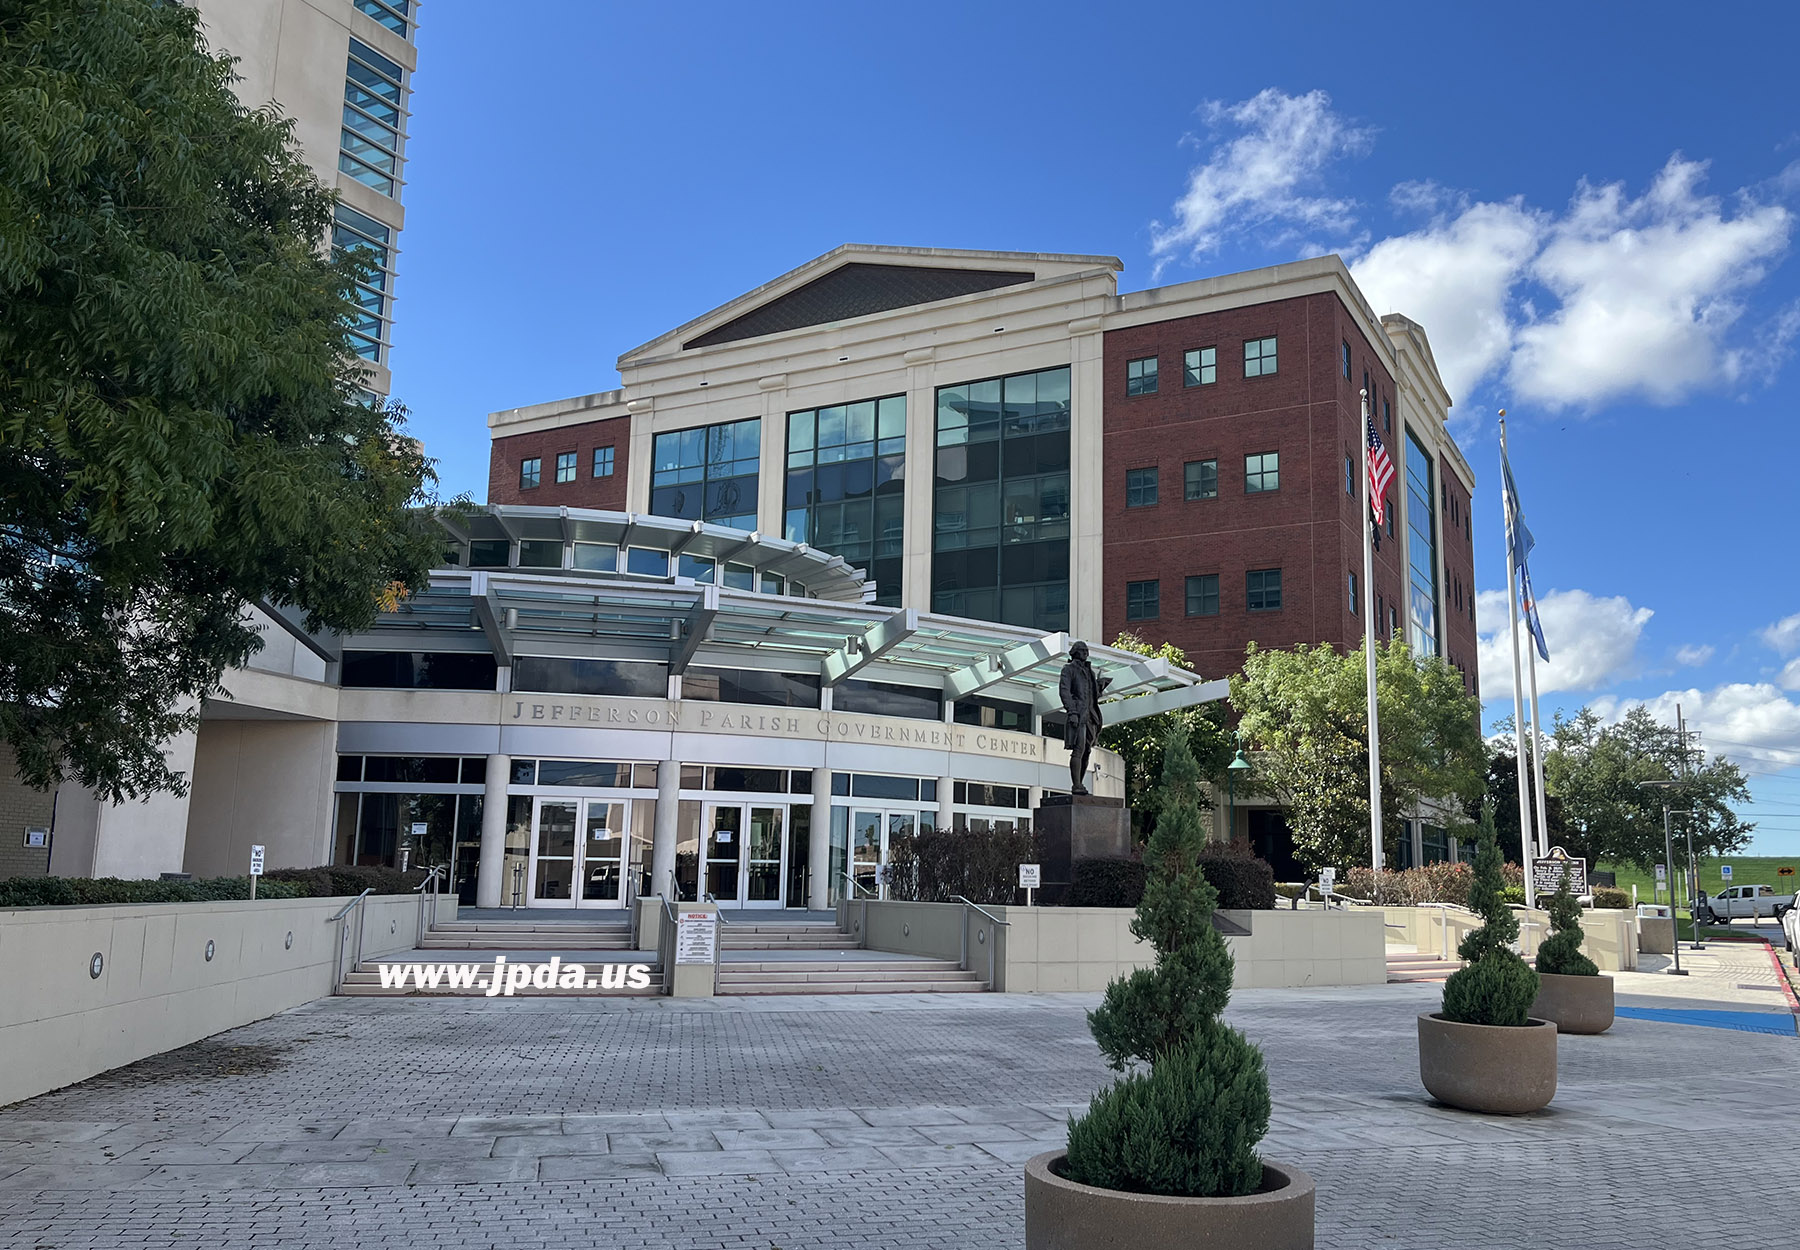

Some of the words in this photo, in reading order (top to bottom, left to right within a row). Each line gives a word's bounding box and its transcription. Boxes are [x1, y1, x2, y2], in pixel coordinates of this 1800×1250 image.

[513, 701, 682, 727] JEFFERSON
[700, 709, 800, 733] PARISH
[816, 718, 966, 747] GOVERNMENT
[975, 733, 1038, 756] CENTER
